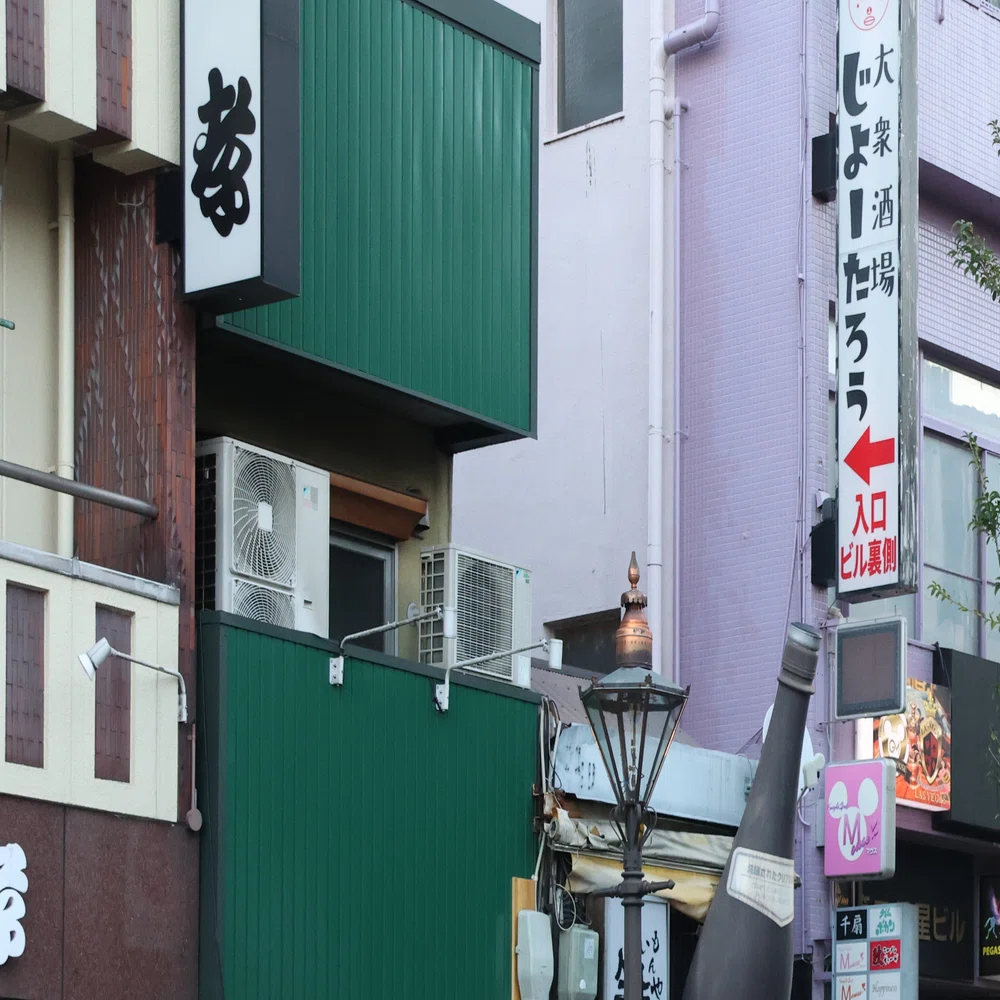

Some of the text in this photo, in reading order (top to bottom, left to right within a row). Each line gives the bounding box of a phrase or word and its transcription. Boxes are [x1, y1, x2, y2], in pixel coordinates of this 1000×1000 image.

[870, 43, 895, 298] 大衆酒場
[843, 51, 871, 421] じょーたろう
[851, 490, 887, 537] 入口
[840, 535, 897, 580] ビル裏側
[840, 914, 863, 938] 千扇
